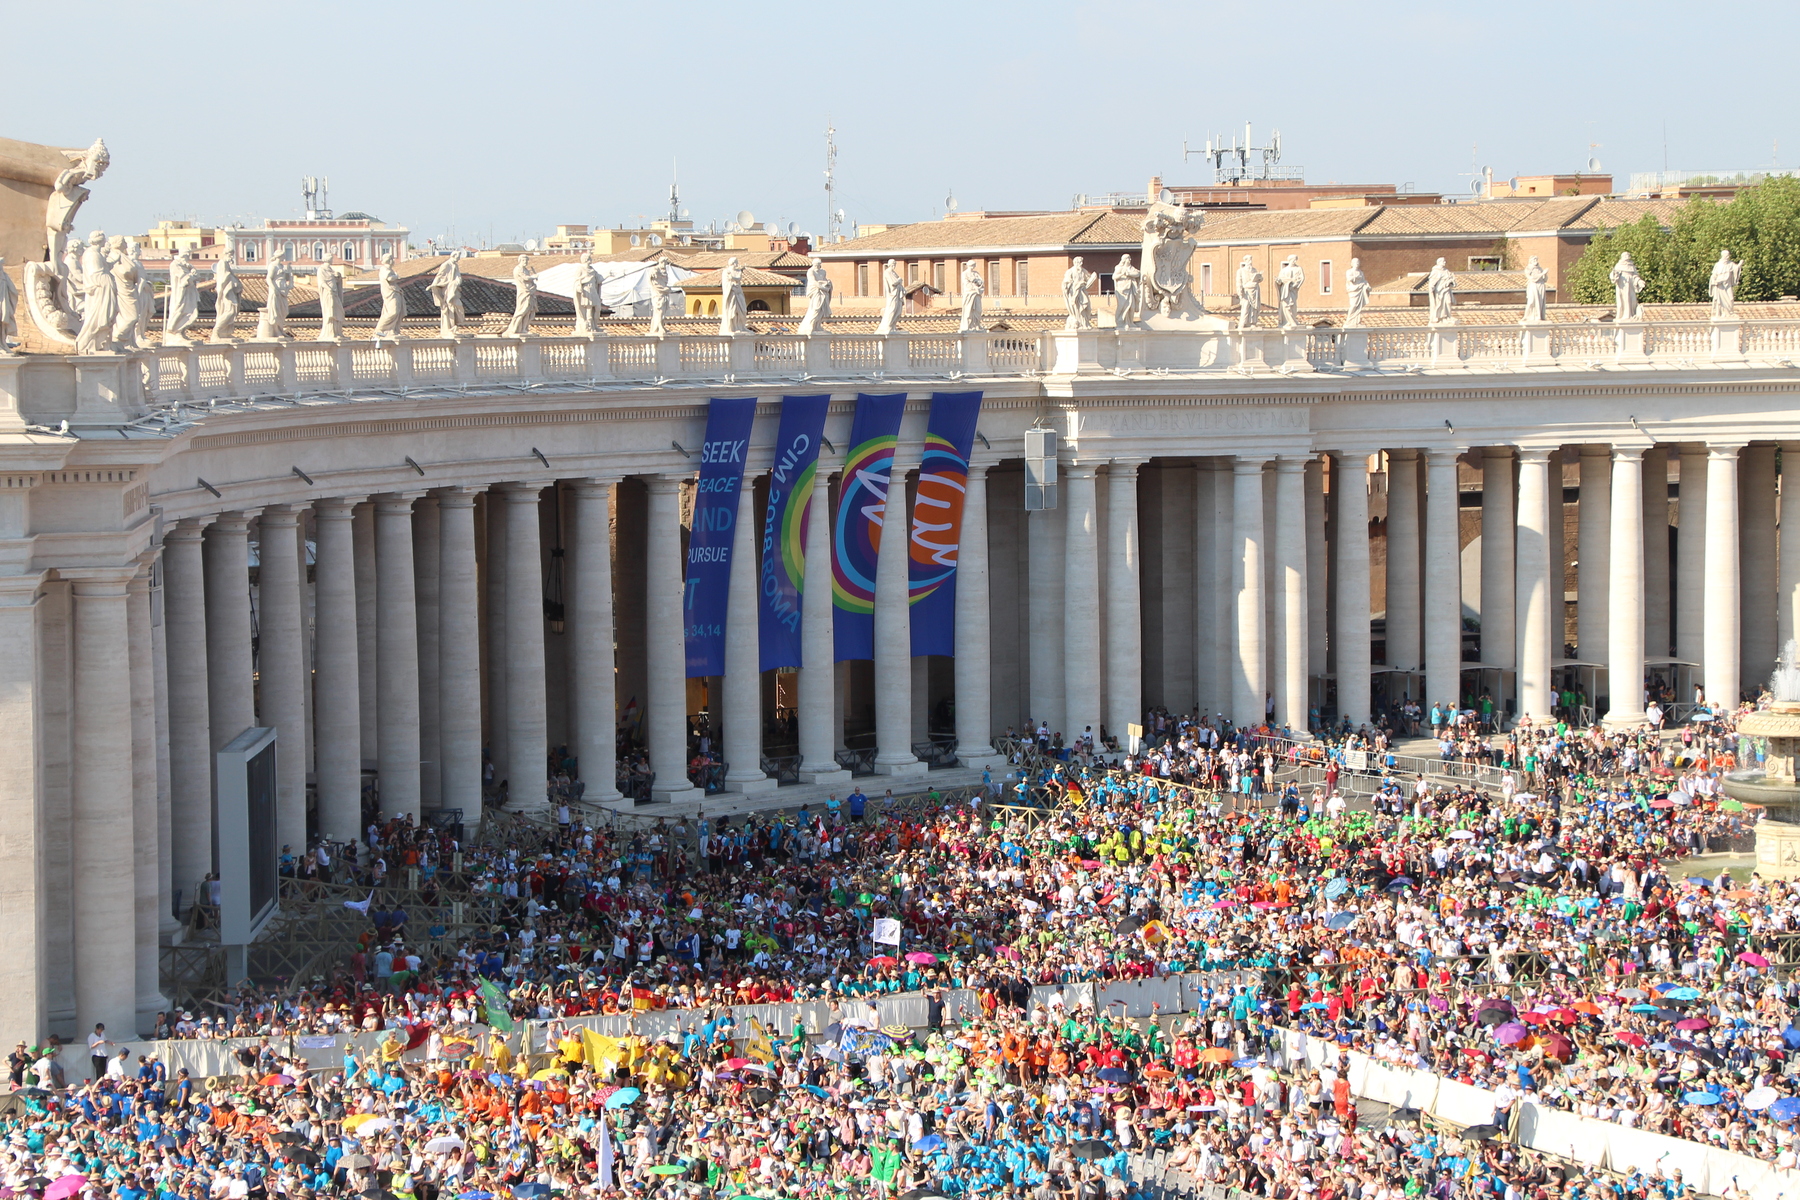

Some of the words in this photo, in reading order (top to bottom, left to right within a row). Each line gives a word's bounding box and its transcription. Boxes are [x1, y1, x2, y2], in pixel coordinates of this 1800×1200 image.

[701, 439, 745, 463] SEEK
[774, 433, 810, 484] CIM
[692, 507, 733, 532] AND
[685, 577, 701, 610] T
[762, 557, 801, 633] ROMA
[691, 624, 721, 638] 34,14
